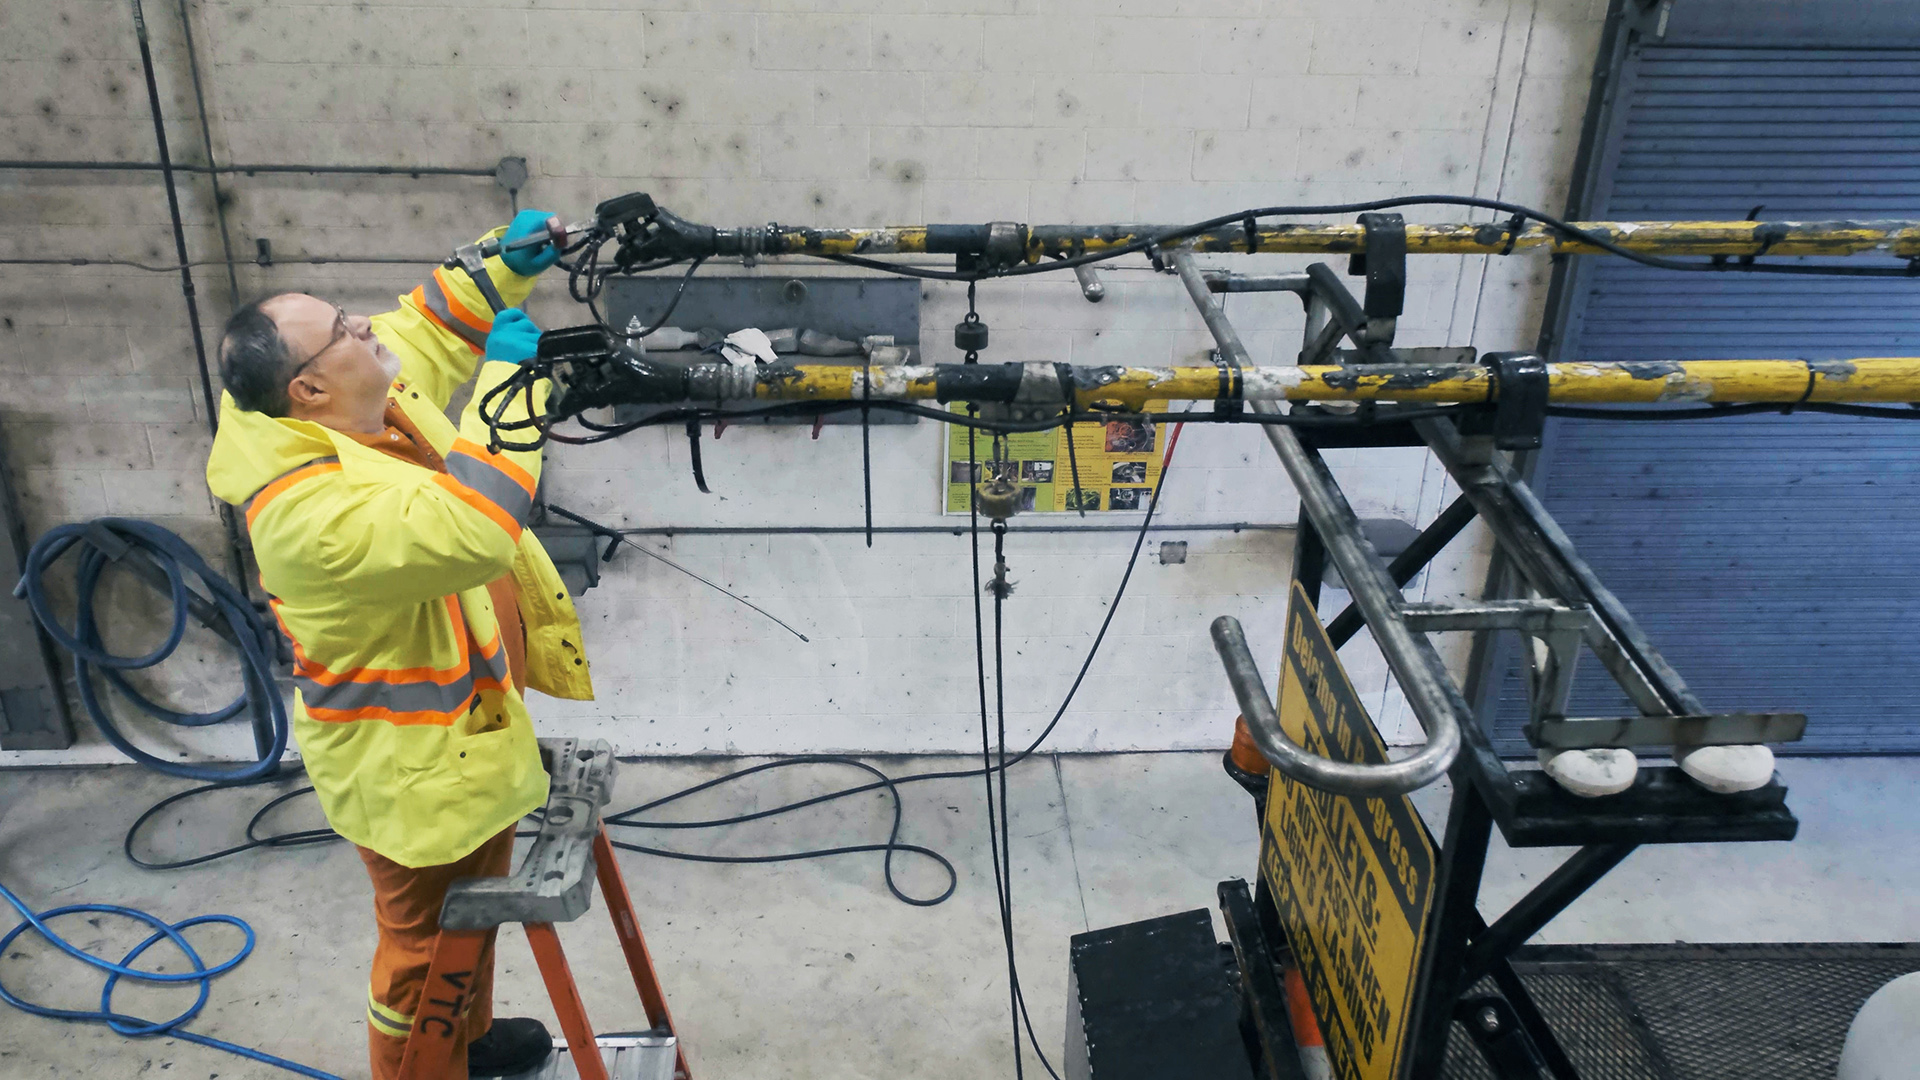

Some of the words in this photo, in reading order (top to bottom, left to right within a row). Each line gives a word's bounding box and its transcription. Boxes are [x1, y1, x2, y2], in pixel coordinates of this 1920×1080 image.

[1293, 612, 1337, 734] Deicing
[1338, 703, 1351, 760] in
[1353, 736, 1418, 905] Pgress
[420, 970, 472, 1038] VTC
[1267, 840, 1290, 905] KEEP
[1289, 901, 1314, 982] BACK
[1314, 971, 1329, 1022] 50
[1329, 1012, 1359, 1080] MET
[1281, 799, 1316, 907] LIGHTS
[1317, 896, 1374, 1066] FLASHING
[1296, 786, 1318, 855] NOT
[1318, 844, 1350, 938] PASS
[1352, 924, 1390, 1044] WHEN
